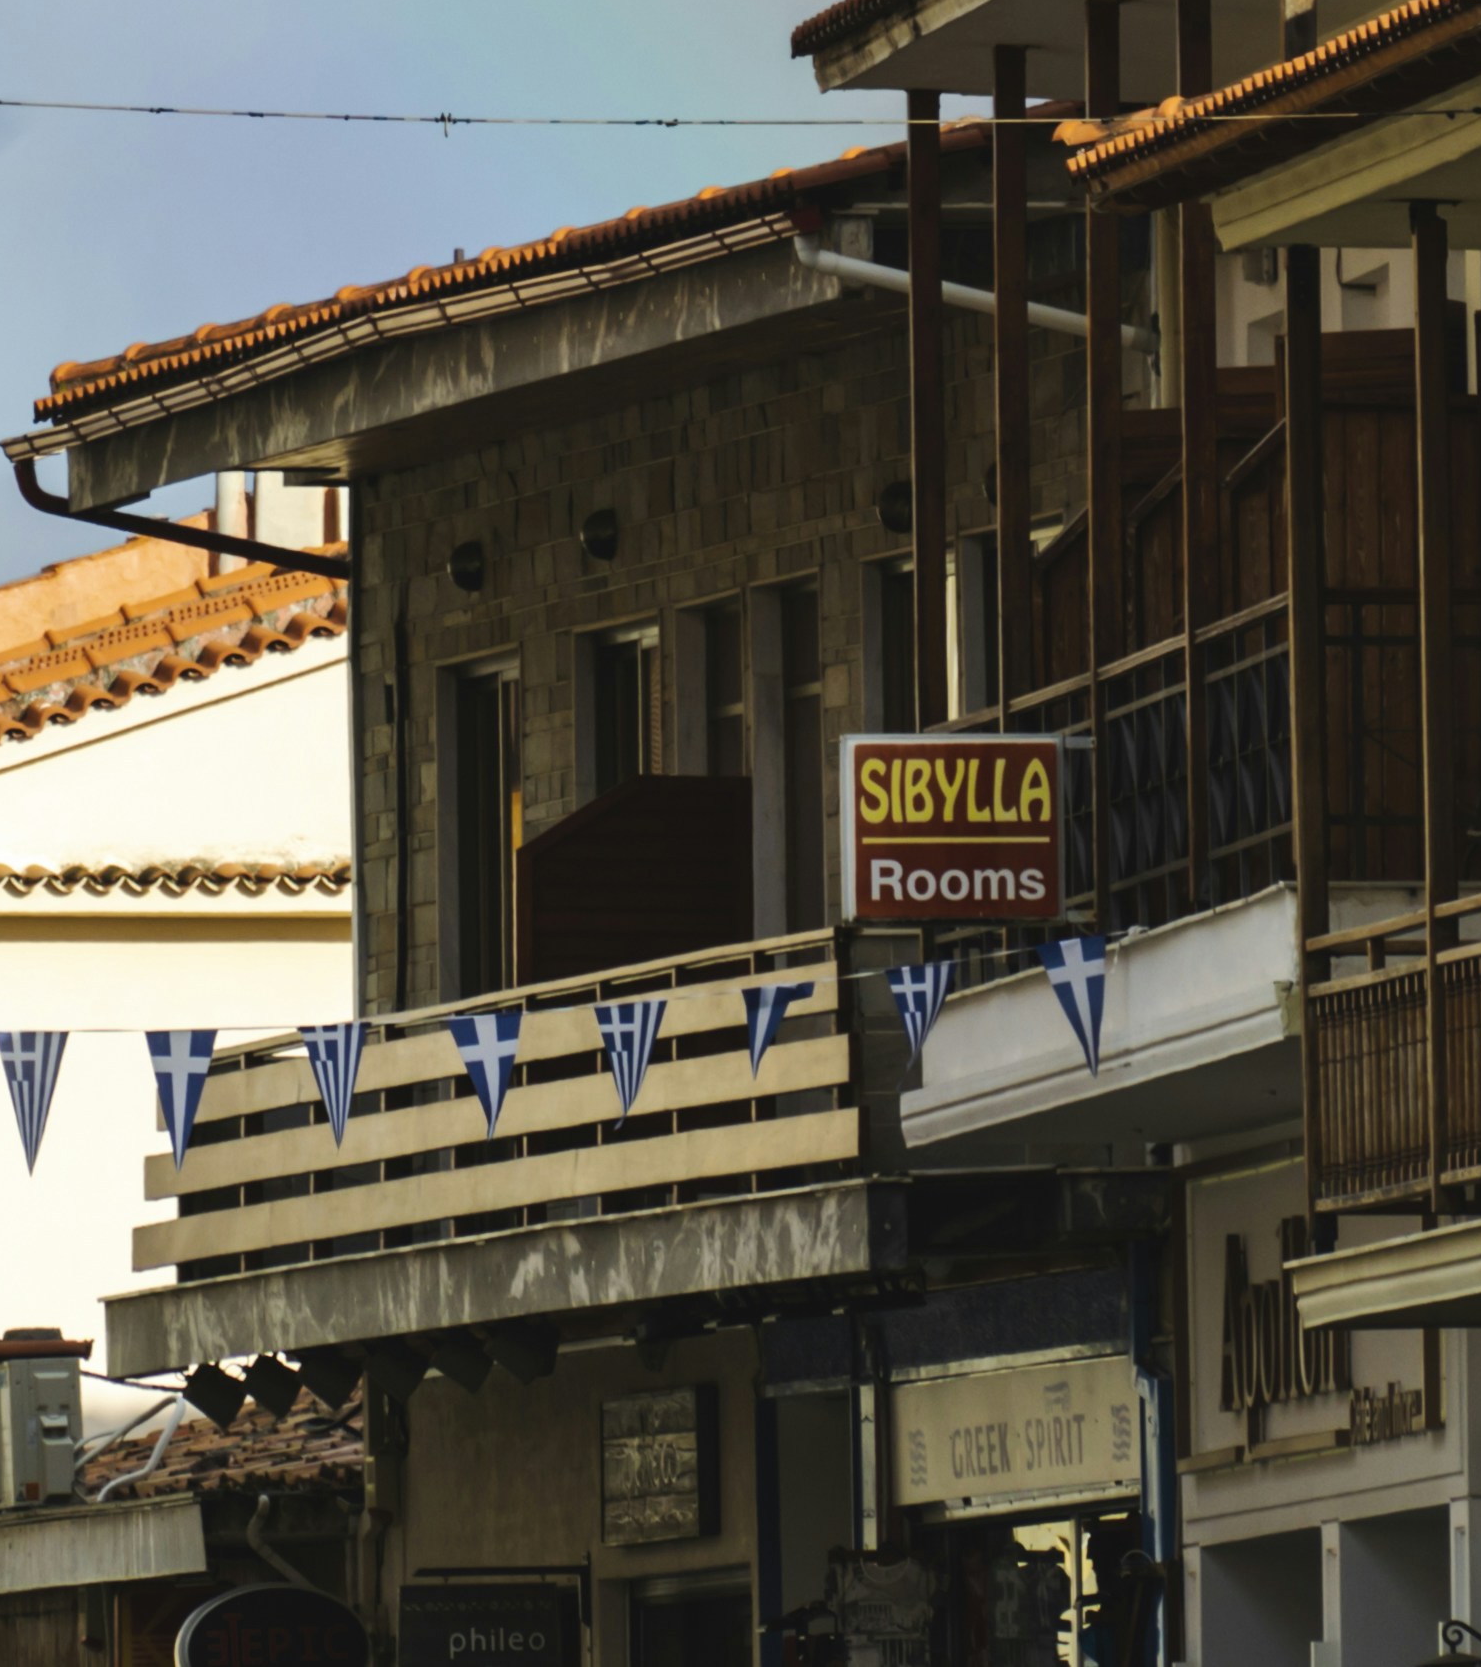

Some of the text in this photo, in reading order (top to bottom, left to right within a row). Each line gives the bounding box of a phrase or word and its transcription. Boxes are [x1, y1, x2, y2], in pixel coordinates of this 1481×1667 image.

[859, 757, 1052, 824] SIBYLLA
[870, 858, 1047, 902] Rooms
[950, 1414, 1086, 1480] GREEK SPIRIT
[449, 1626, 546, 1660] phileo
